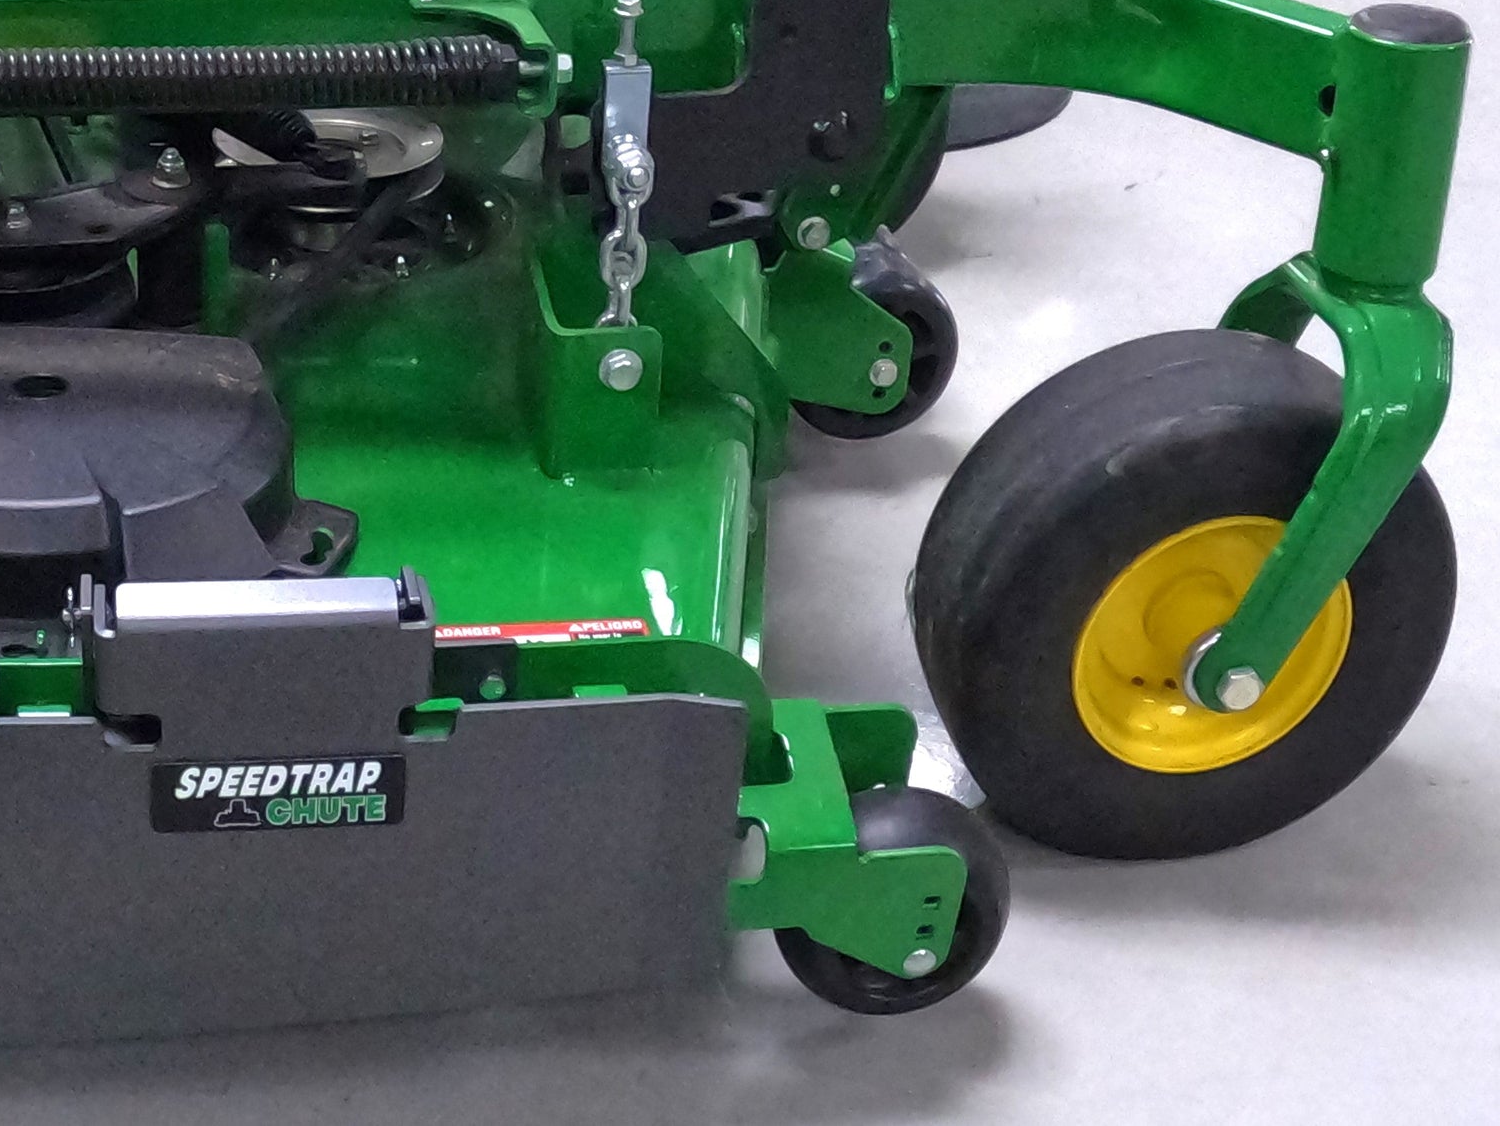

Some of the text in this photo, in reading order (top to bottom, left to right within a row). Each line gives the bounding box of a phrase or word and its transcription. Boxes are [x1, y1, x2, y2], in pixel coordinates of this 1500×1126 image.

[443, 626, 501, 637] DANGER
[582, 619, 643, 631] PELIGRO
[174, 760, 383, 800] SPEEDTRAP
[265, 794, 388, 826] CHUTE
